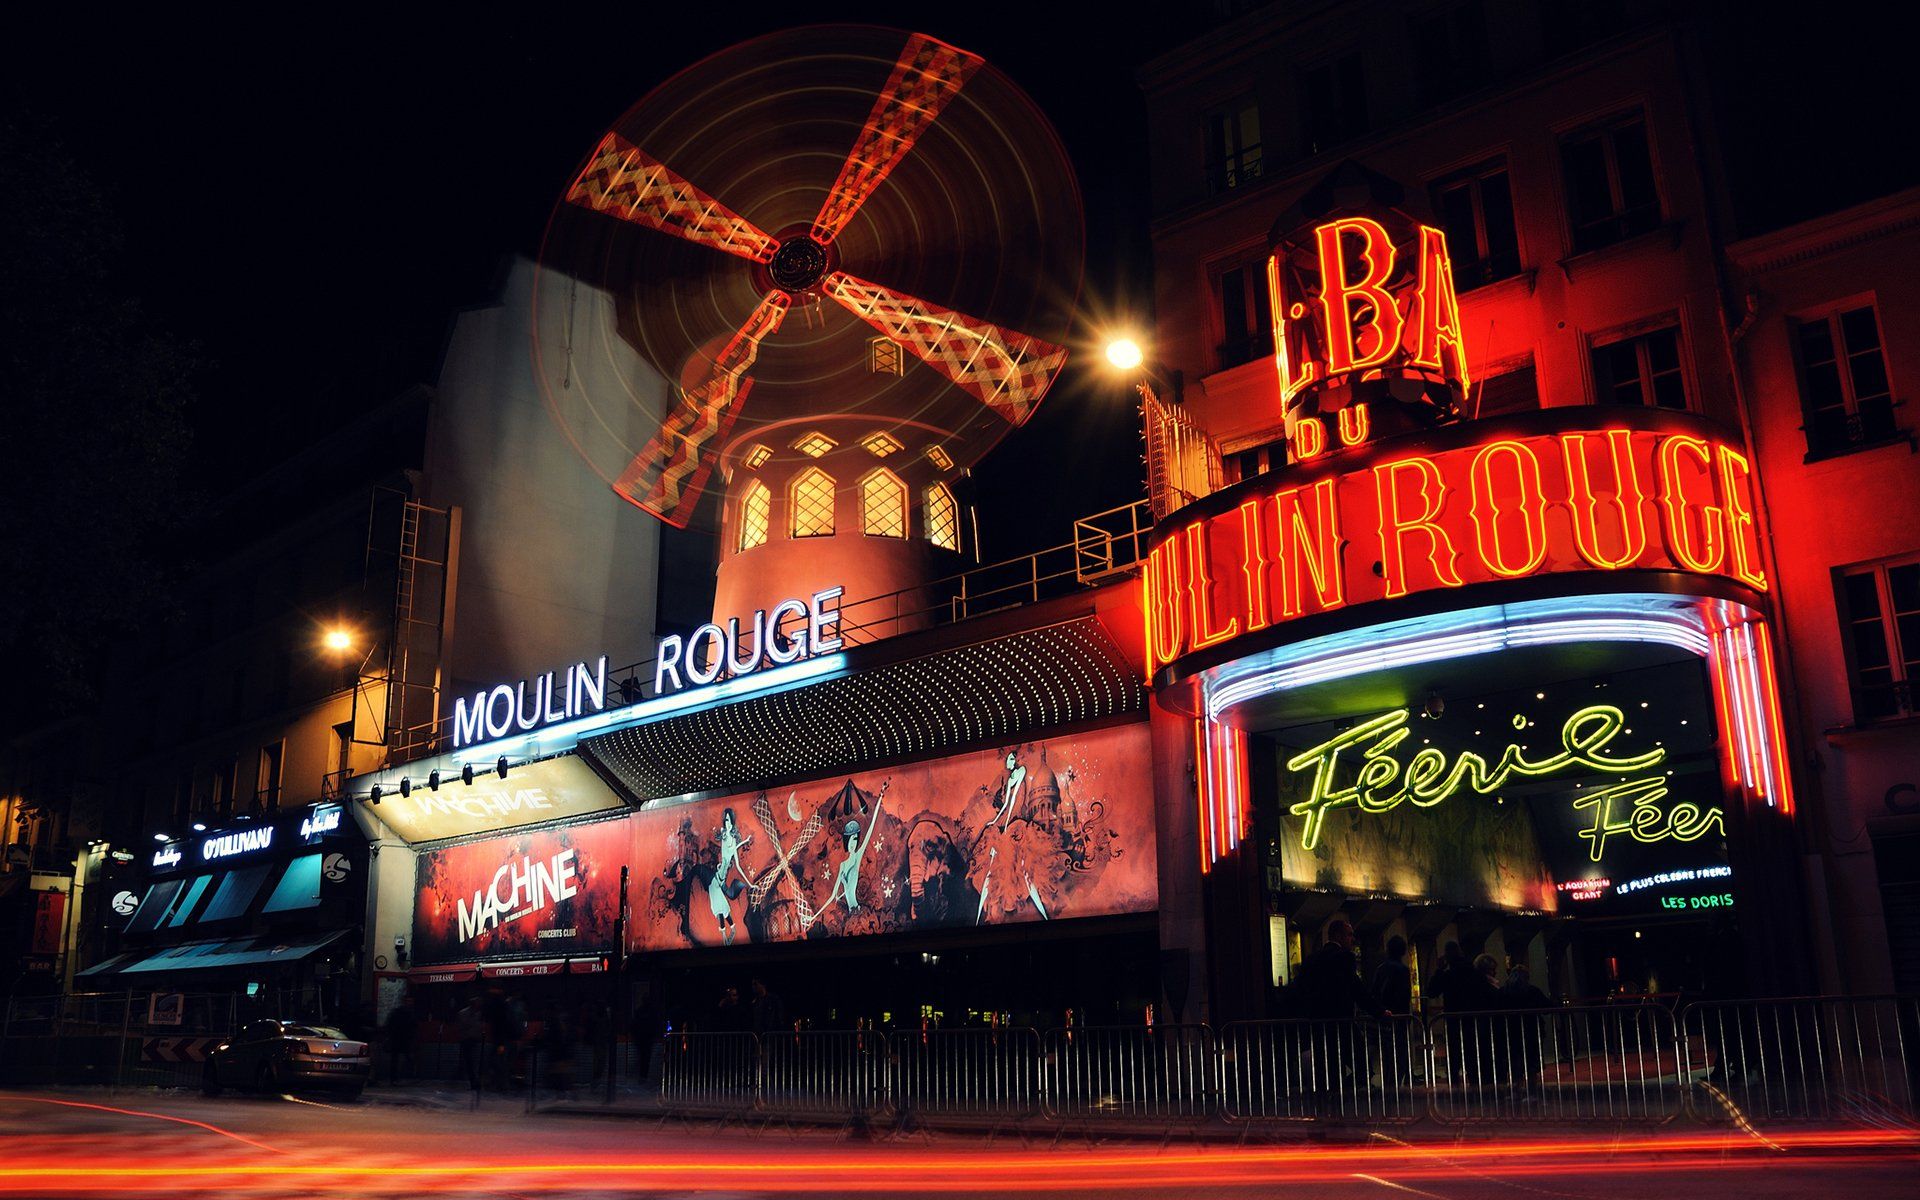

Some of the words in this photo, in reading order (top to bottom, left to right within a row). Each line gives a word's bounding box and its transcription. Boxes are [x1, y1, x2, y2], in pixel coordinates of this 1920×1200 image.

[1294, 403, 1368, 459] DU
[1373, 429, 1769, 599] ROUGE
[452, 653, 610, 748] MOULIN
[653, 584, 847, 695] ROUGE
[1286, 704, 1667, 851] Féerie
[457, 848, 578, 944] MACHINE
[1616, 883, 1629, 895] LE
[1629, 877, 1655, 891] PLUS
[1661, 896, 1687, 908] LES
[1690, 893, 1734, 909] DORIS
[537, 929, 563, 939] CONCERTS
[563, 928, 577, 938] CLUB
[429, 974, 455, 983] TERRASSE
[495, 967, 524, 976] CONCERTS
[532, 966, 548, 975] CLUB
